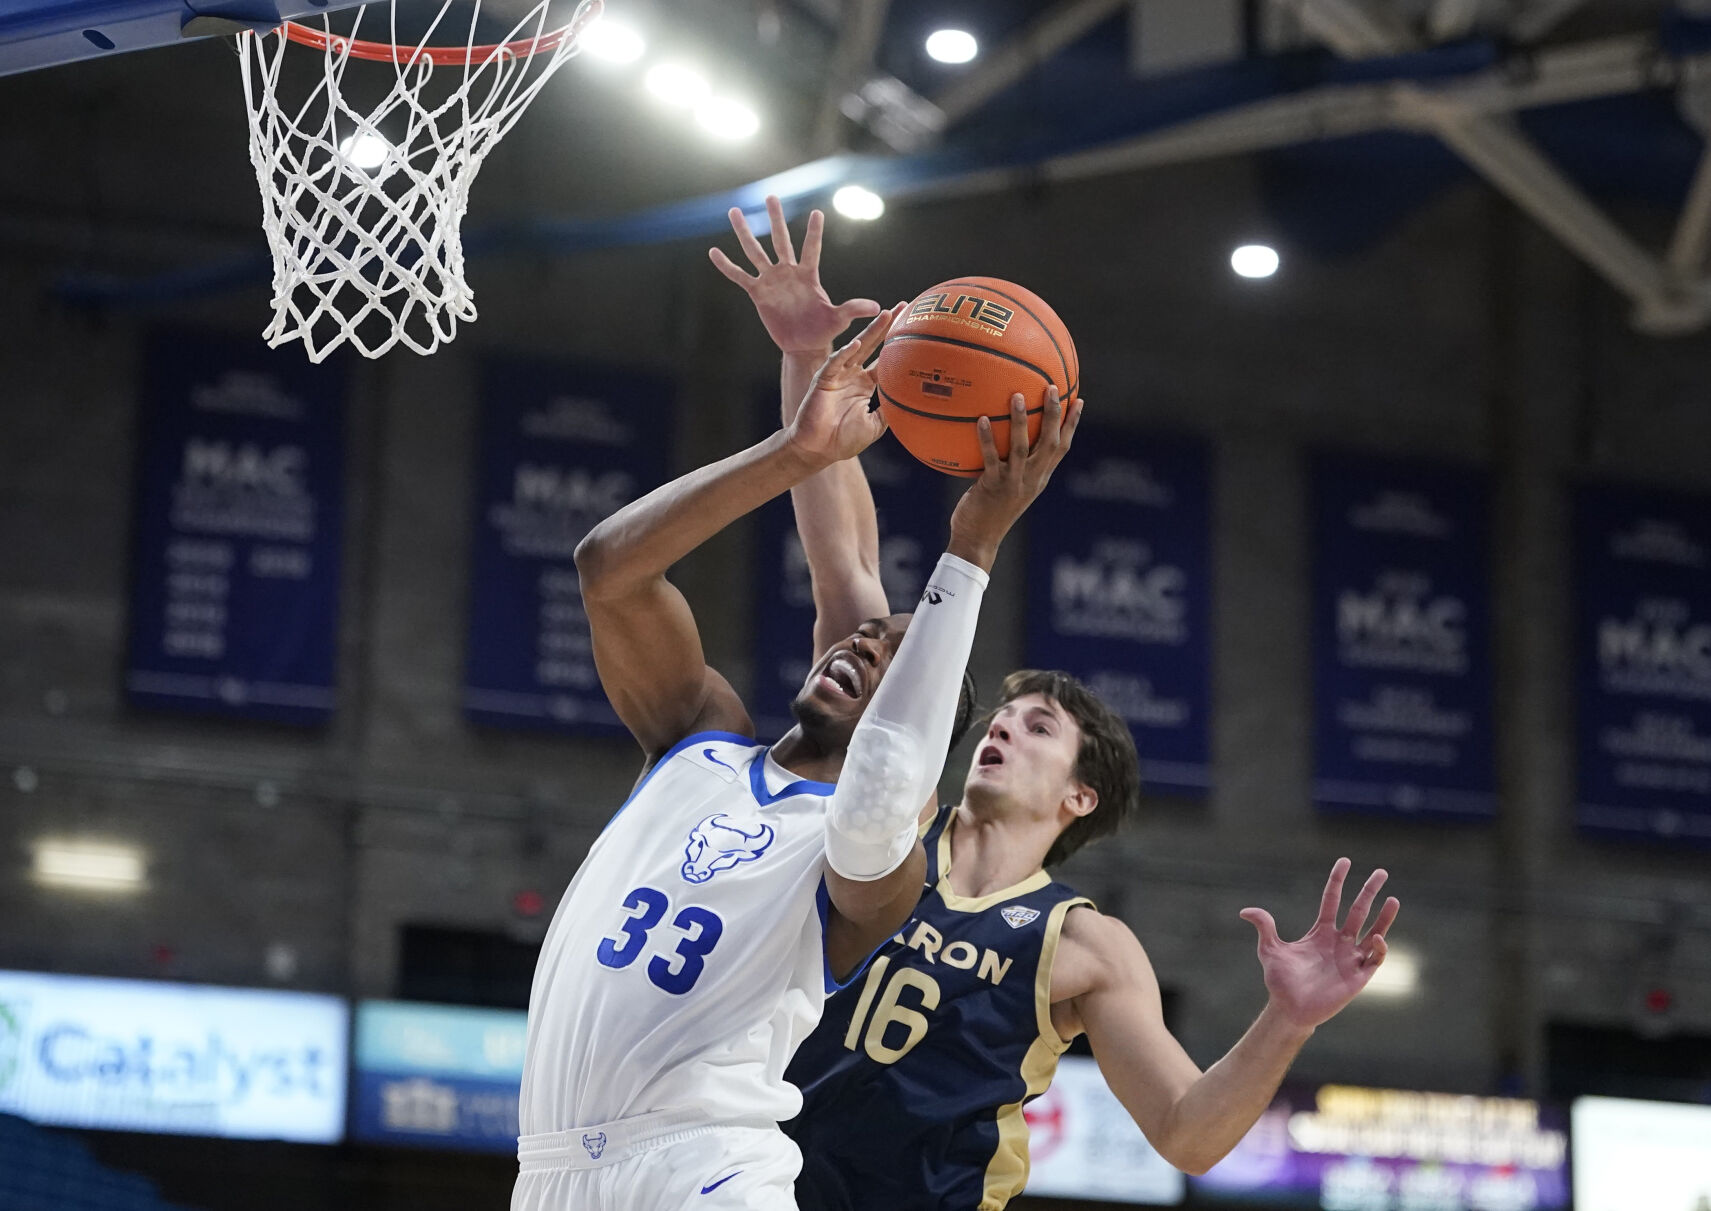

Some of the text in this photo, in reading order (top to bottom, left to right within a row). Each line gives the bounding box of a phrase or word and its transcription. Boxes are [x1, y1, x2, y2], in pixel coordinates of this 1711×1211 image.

[906, 315, 1003, 338] CHAMPIONSHIP
[909, 293, 1014, 331] ELITE
[597, 887, 723, 996] 33
[844, 955, 941, 1065] 16
[38, 1023, 326, 1104] Catalyst
